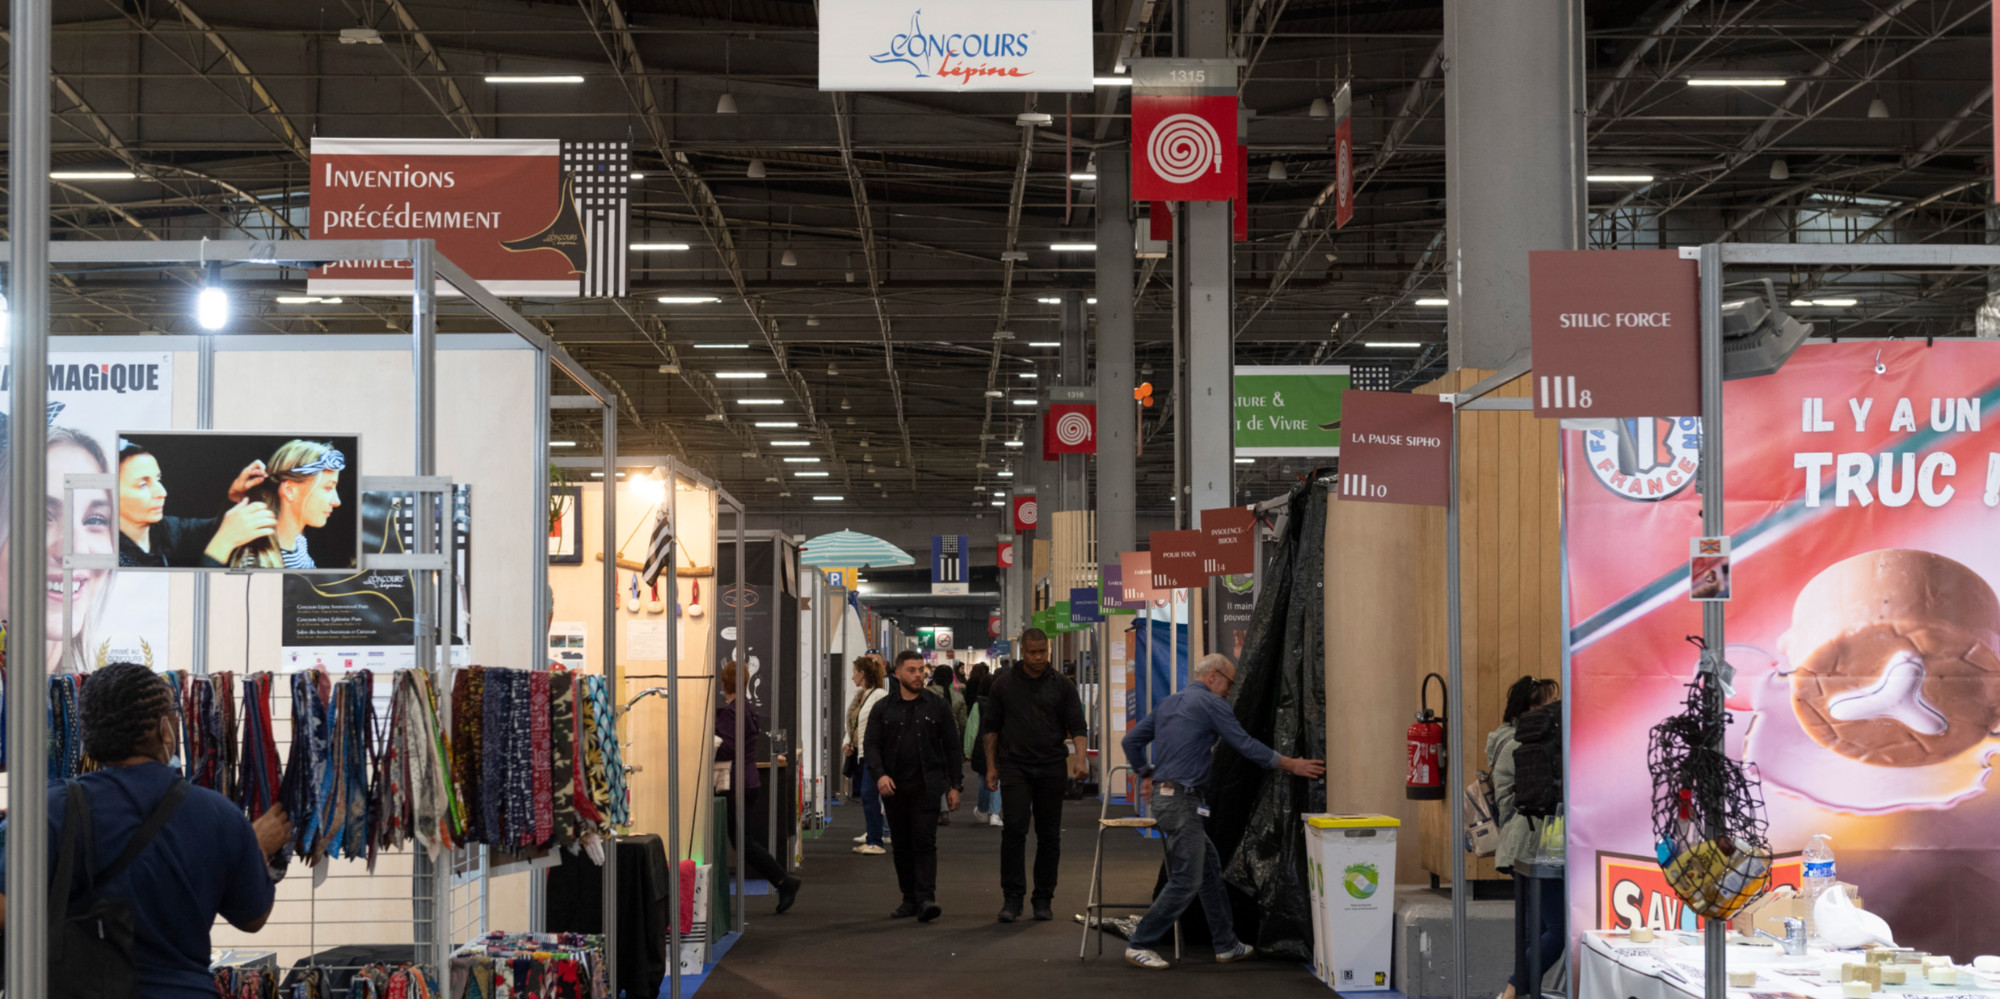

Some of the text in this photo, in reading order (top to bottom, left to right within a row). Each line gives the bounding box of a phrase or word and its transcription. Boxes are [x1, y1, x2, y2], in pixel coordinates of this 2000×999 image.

[890, 33, 1029, 58] CONCOURS
[1169, 70, 1205, 83] 1315
[1559, 312, 1672, 328] STILIC FORCE
[1272, 391, 1285, 407] &
[1802, 397, 1981, 432] IL Y A UN
[1352, 432, 1441, 448] LA PAUSE SIPHO
[1597, 457, 1696, 495] FRANCE
[1793, 452, 1957, 508] TRUC
[1370, 484, 1387, 498] 10
[1234, 602, 1253, 610] main
